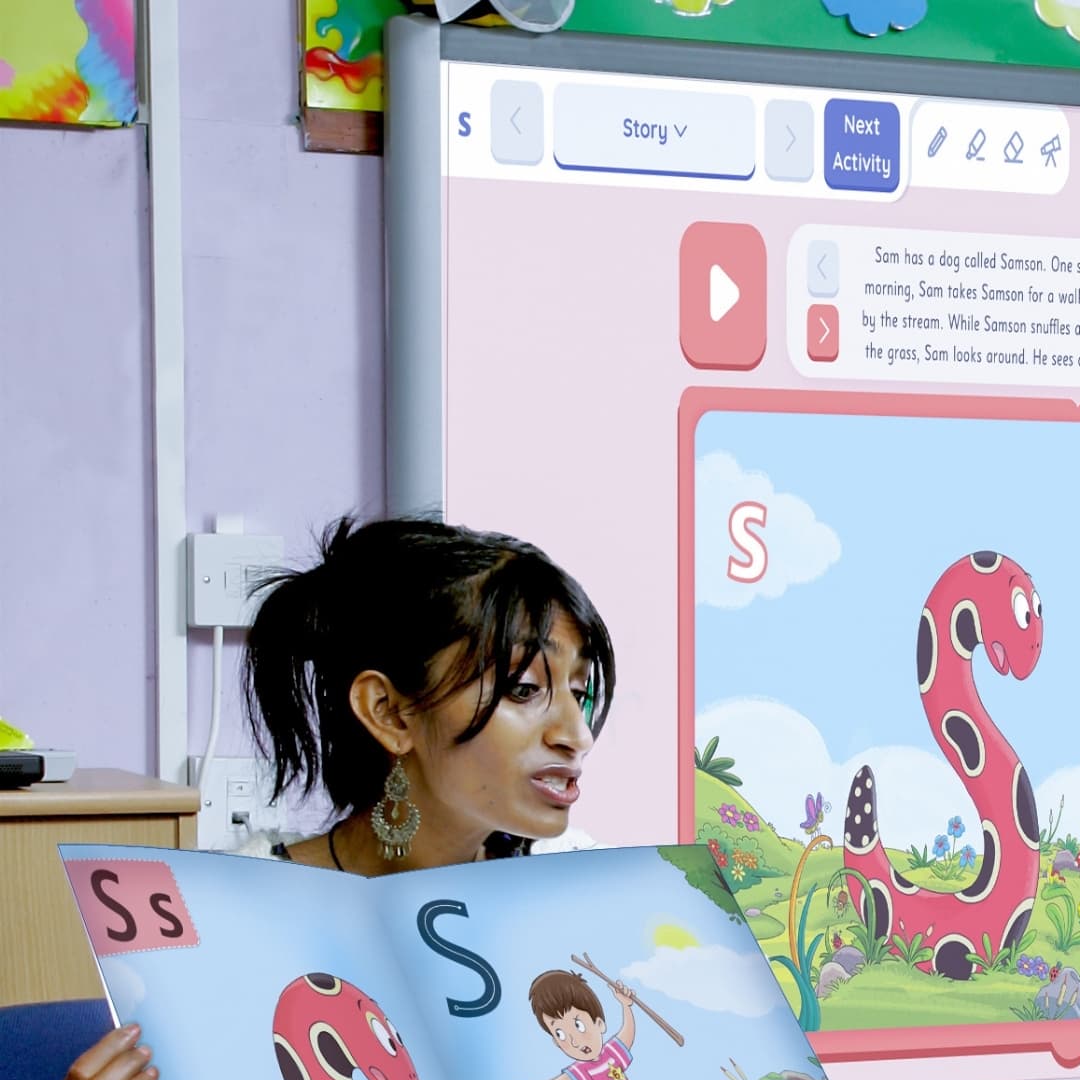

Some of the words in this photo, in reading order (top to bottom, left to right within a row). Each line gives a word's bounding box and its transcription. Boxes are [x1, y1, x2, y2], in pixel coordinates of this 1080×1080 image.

[622, 117, 669, 145] Story
[843, 114, 881, 136] Next
[832, 151, 891, 180] Activity
[875, 246, 900, 264] Sam
[904, 247, 924, 266] has
[928, 254, 935, 266] a
[940, 249, 960, 273] dog
[964, 251, 996, 269] called
[1000, 252, 1047, 272] Samson.
[1051, 255, 1073, 273] One
[864, 280, 915, 302] morning,
[919, 280, 944, 298] Sam
[948, 282, 977, 300] takes
[981, 283, 1024, 302] Samson
[1028, 285, 1044, 302] for
[1048, 291, 1054, 303] a
[862, 309, 876, 333] by
[880, 310, 898, 328] the
[902, 314, 944, 330] stream.
[948, 313, 980, 332] While
[984, 314, 1027, 334] Samson
[1030, 318, 1071, 336] snuffles
[865, 341, 883, 360] the
[887, 347, 920, 366] grass,
[924, 344, 949, 362] Sam
[953, 345, 982, 363] looks
[986, 348, 1028, 365] around.
[1033, 348, 1048, 366] He
[1052, 354, 1074, 367] sees
[90, 868, 137, 942] S
